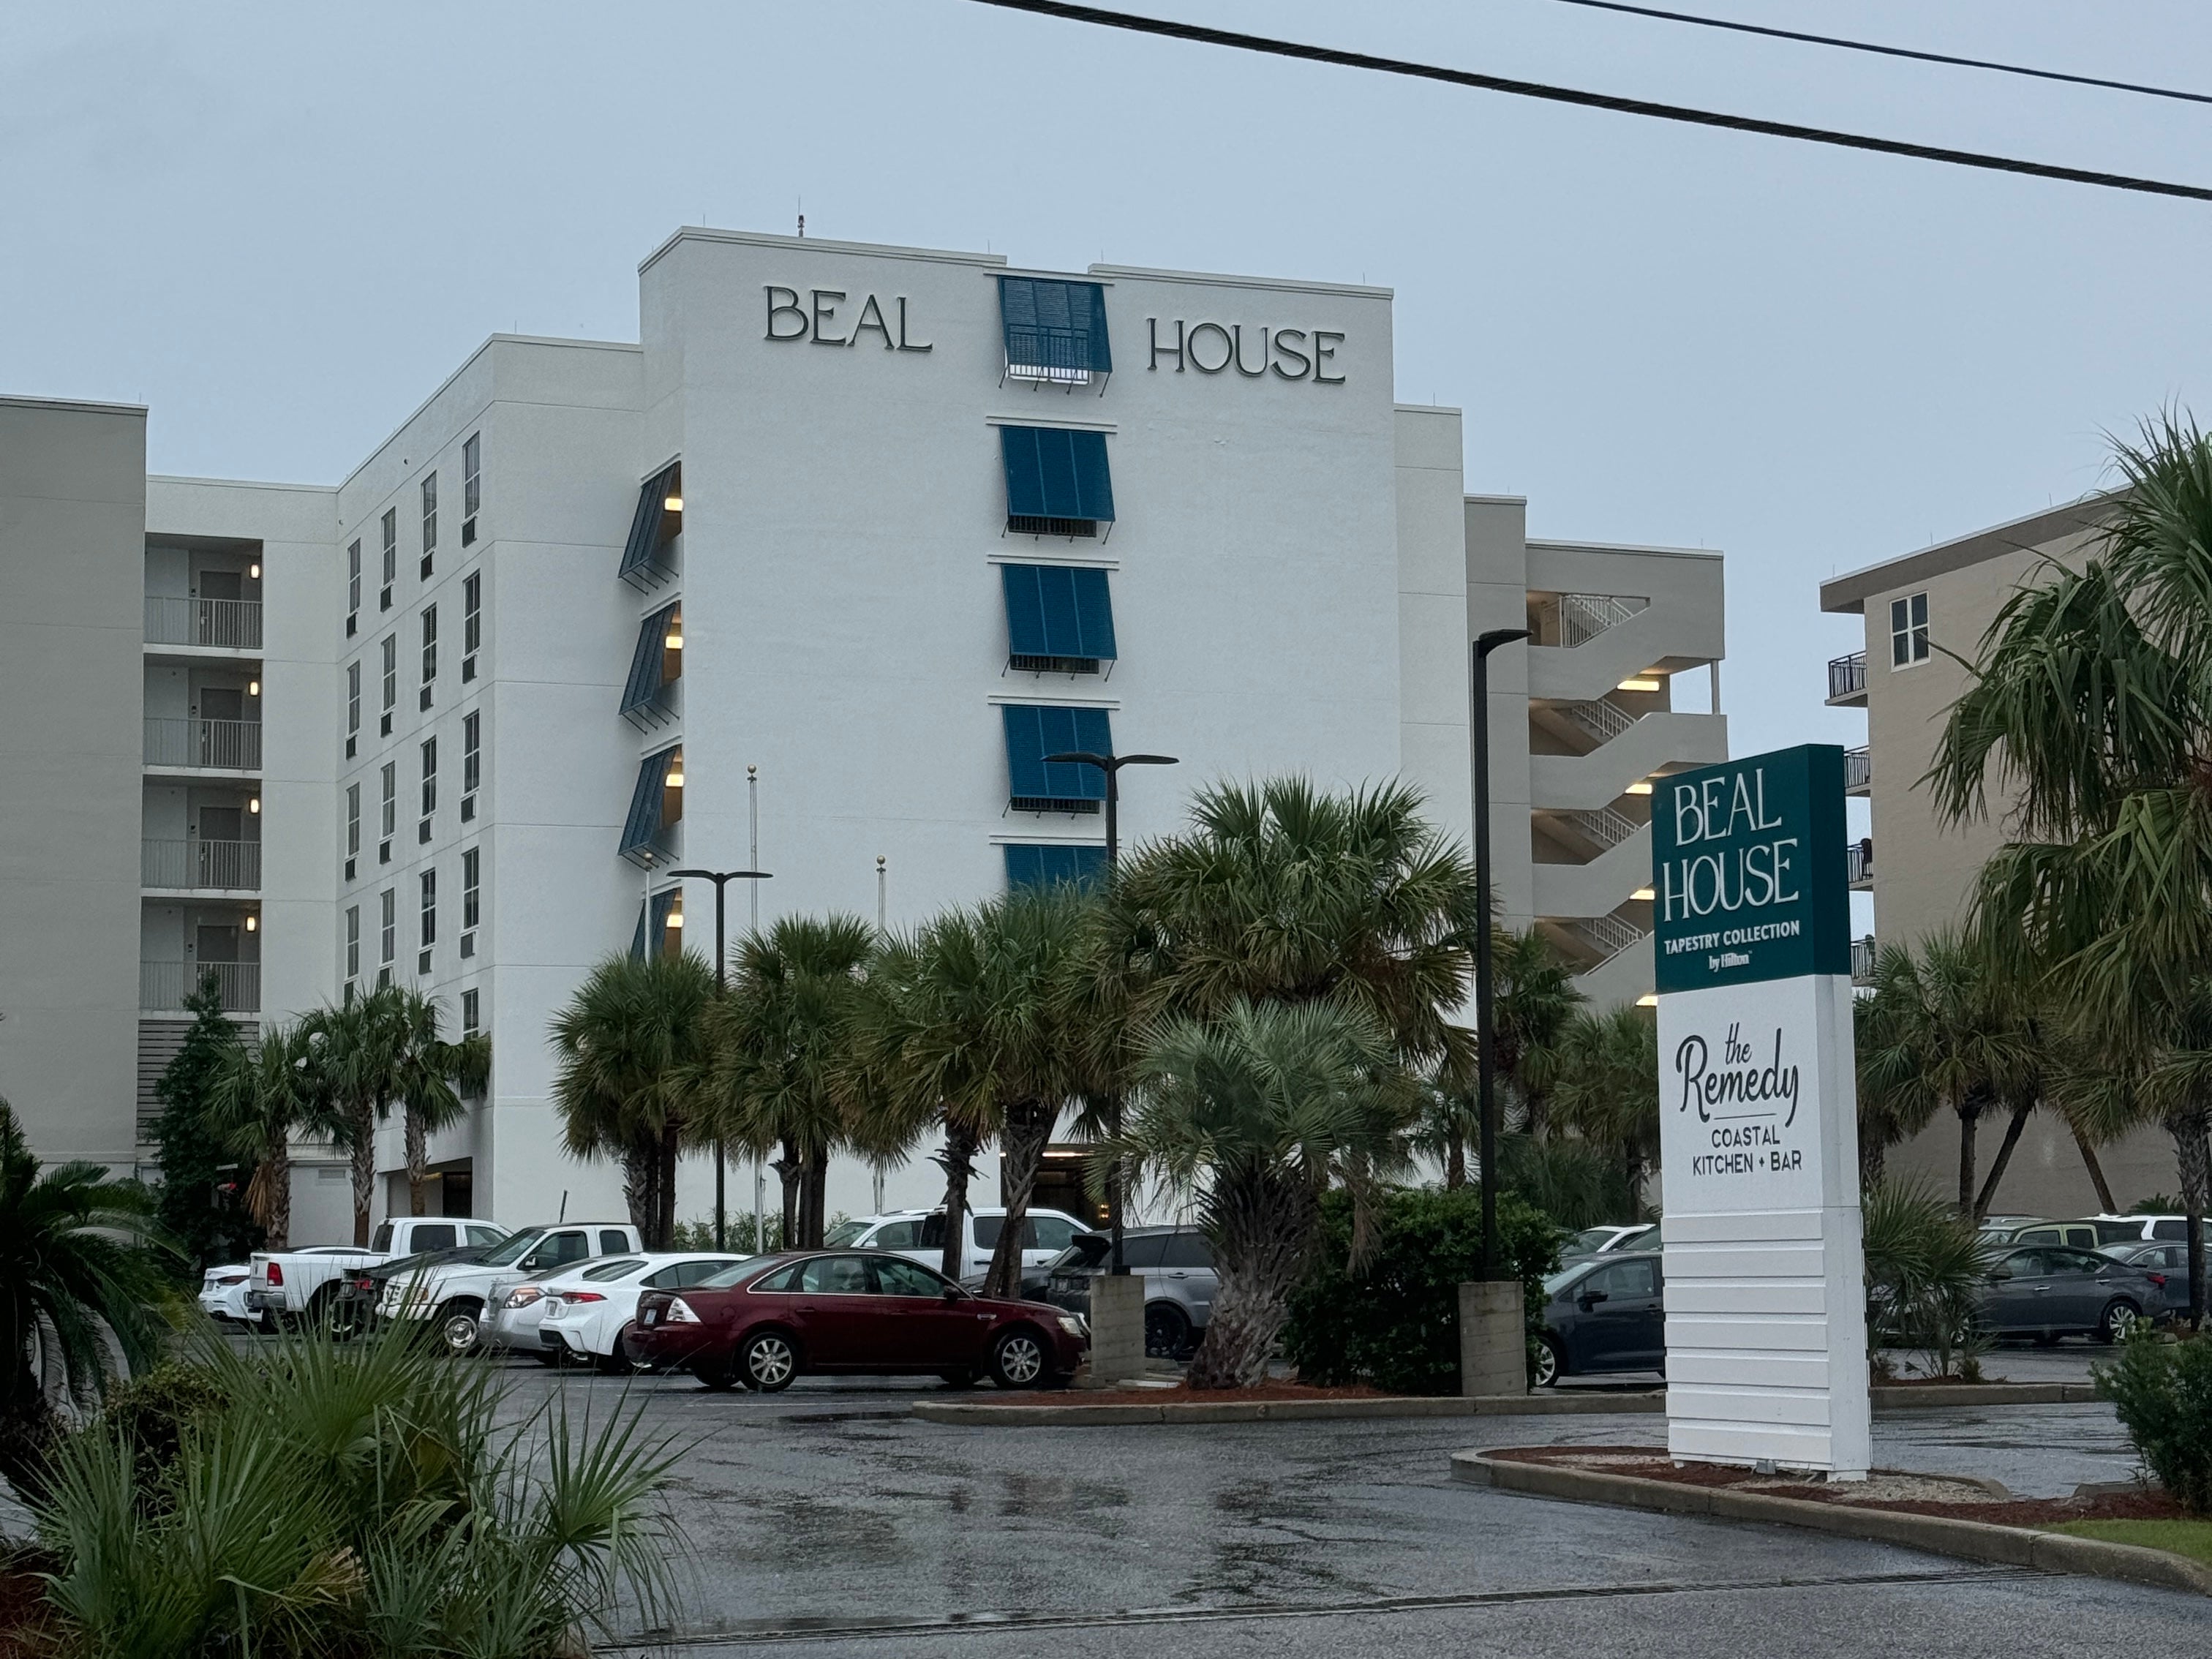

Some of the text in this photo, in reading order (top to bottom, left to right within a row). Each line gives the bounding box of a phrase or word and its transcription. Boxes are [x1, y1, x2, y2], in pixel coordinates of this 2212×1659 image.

[764, 285, 1347, 385] BEAL HOUSE
[1674, 769, 1782, 846] BEAL
[1663, 838, 1799, 922] HOUSE
[1664, 920, 1800, 955] TAPESTRY COLLECTION
[1708, 955, 1720, 973] by
[1725, 1022, 1752, 1065] the
[1676, 1028, 1799, 1128] Remedy
[1712, 1125, 1780, 1148] COASTAL
[1693, 1153, 1753, 1175] KITCHEN
[1770, 1150, 1802, 1171] BAR
